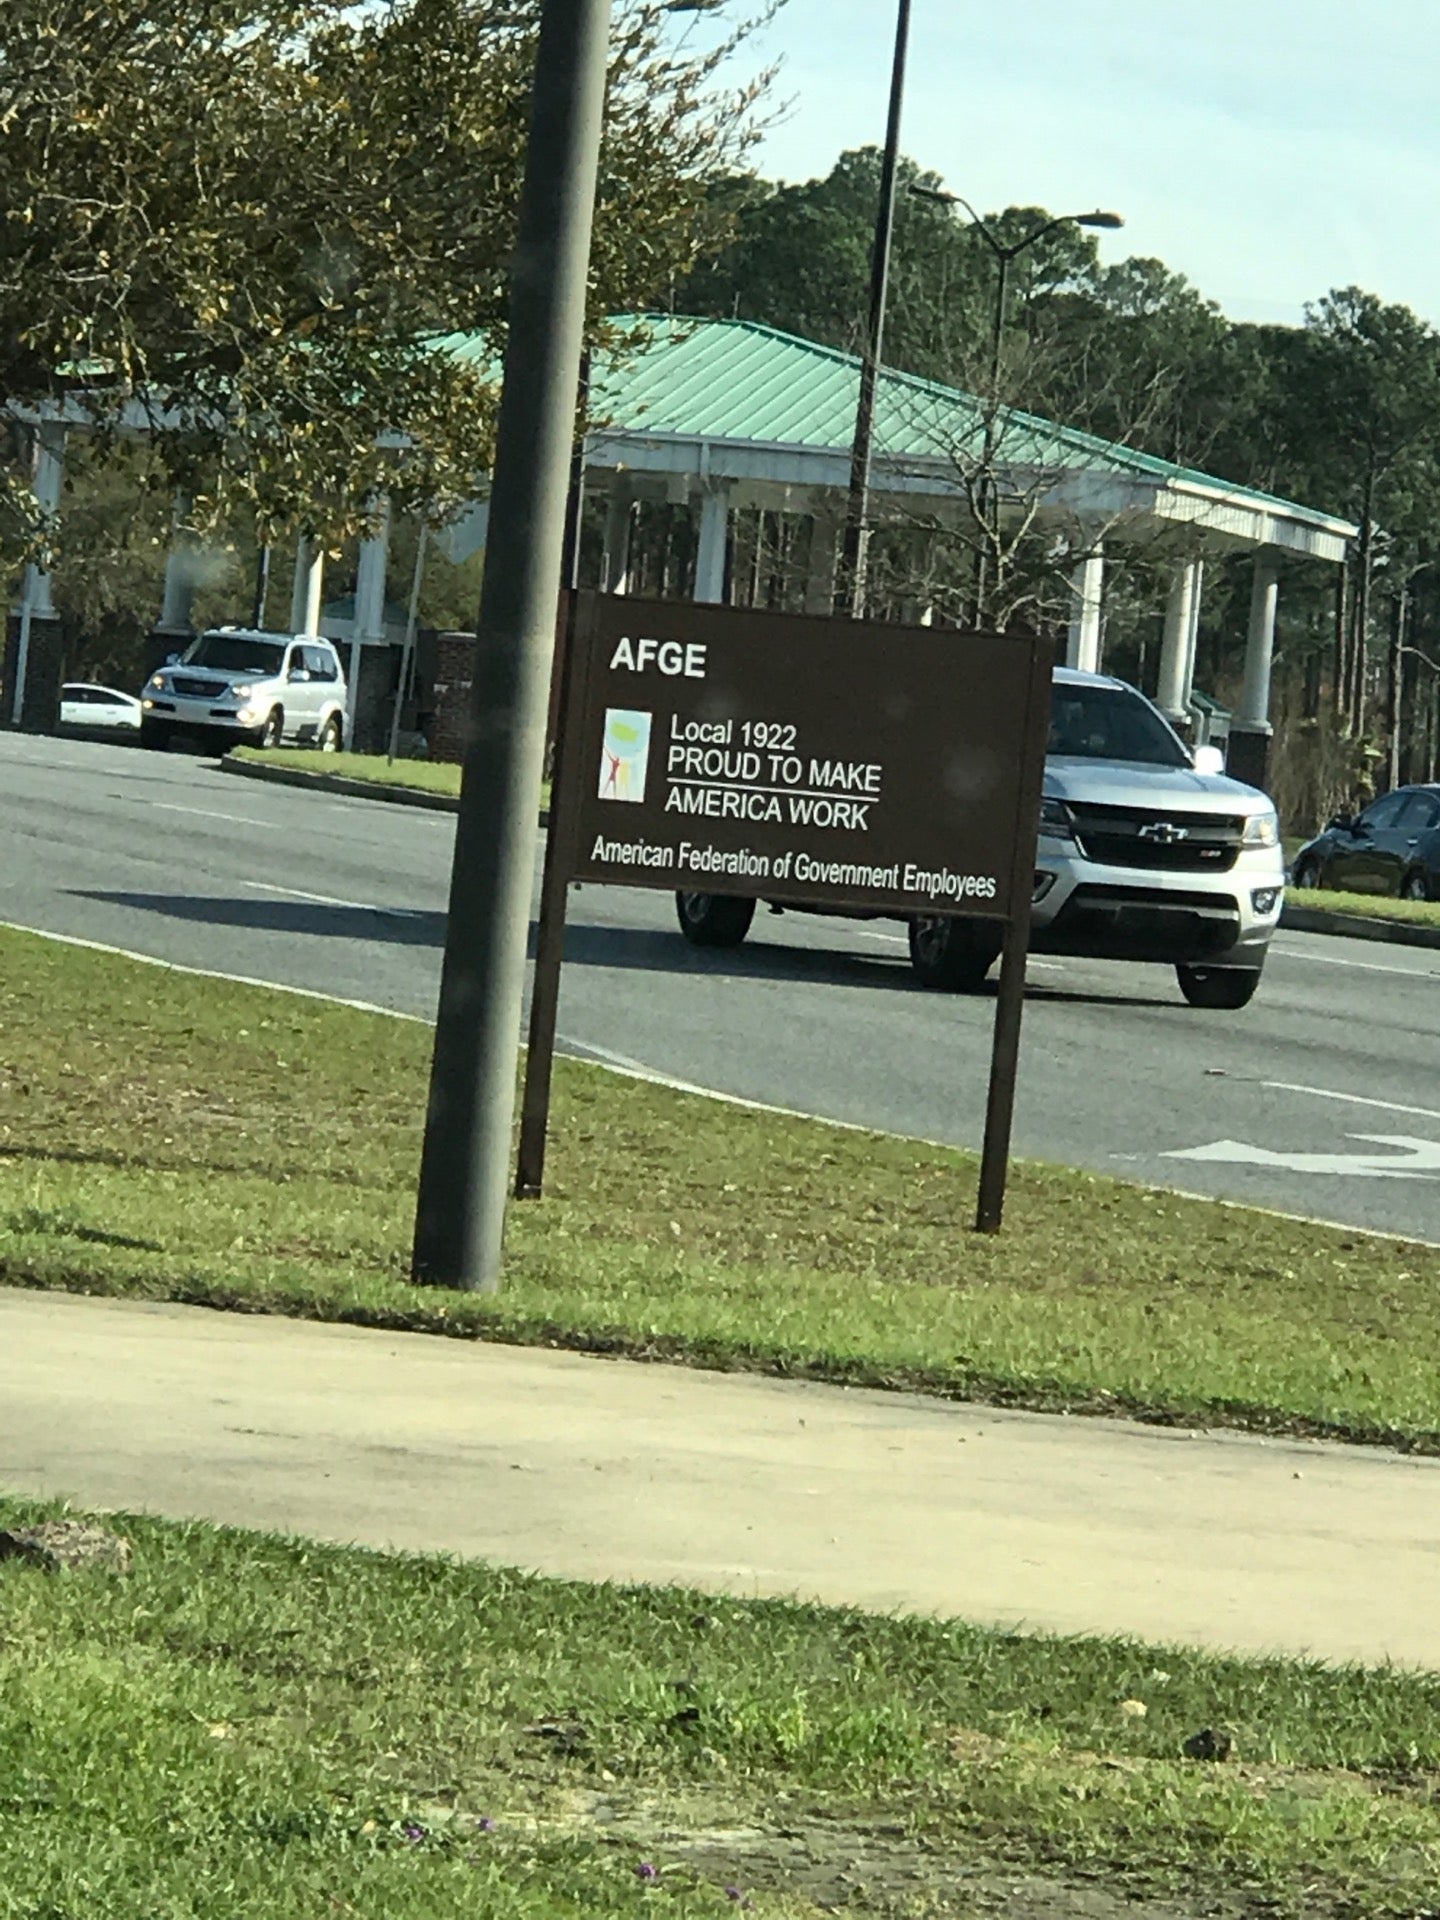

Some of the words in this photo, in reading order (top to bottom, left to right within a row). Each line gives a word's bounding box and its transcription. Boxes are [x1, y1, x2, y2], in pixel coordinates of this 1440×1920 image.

[609, 636, 707, 678] AFGE
[670, 713, 733, 745] Local
[740, 721, 797, 751] 1922
[667, 745, 761, 780] PROUD
[767, 754, 803, 785] TO
[808, 758, 883, 793] MAKE
[664, 785, 783, 823] AMERICA
[788, 797, 870, 831] WORK
[590, 834, 674, 868] American
[677, 841, 770, 877] Federation
[772, 851, 794, 879] of
[794, 852, 900, 890] Government
[902, 863, 997, 902] Employees
